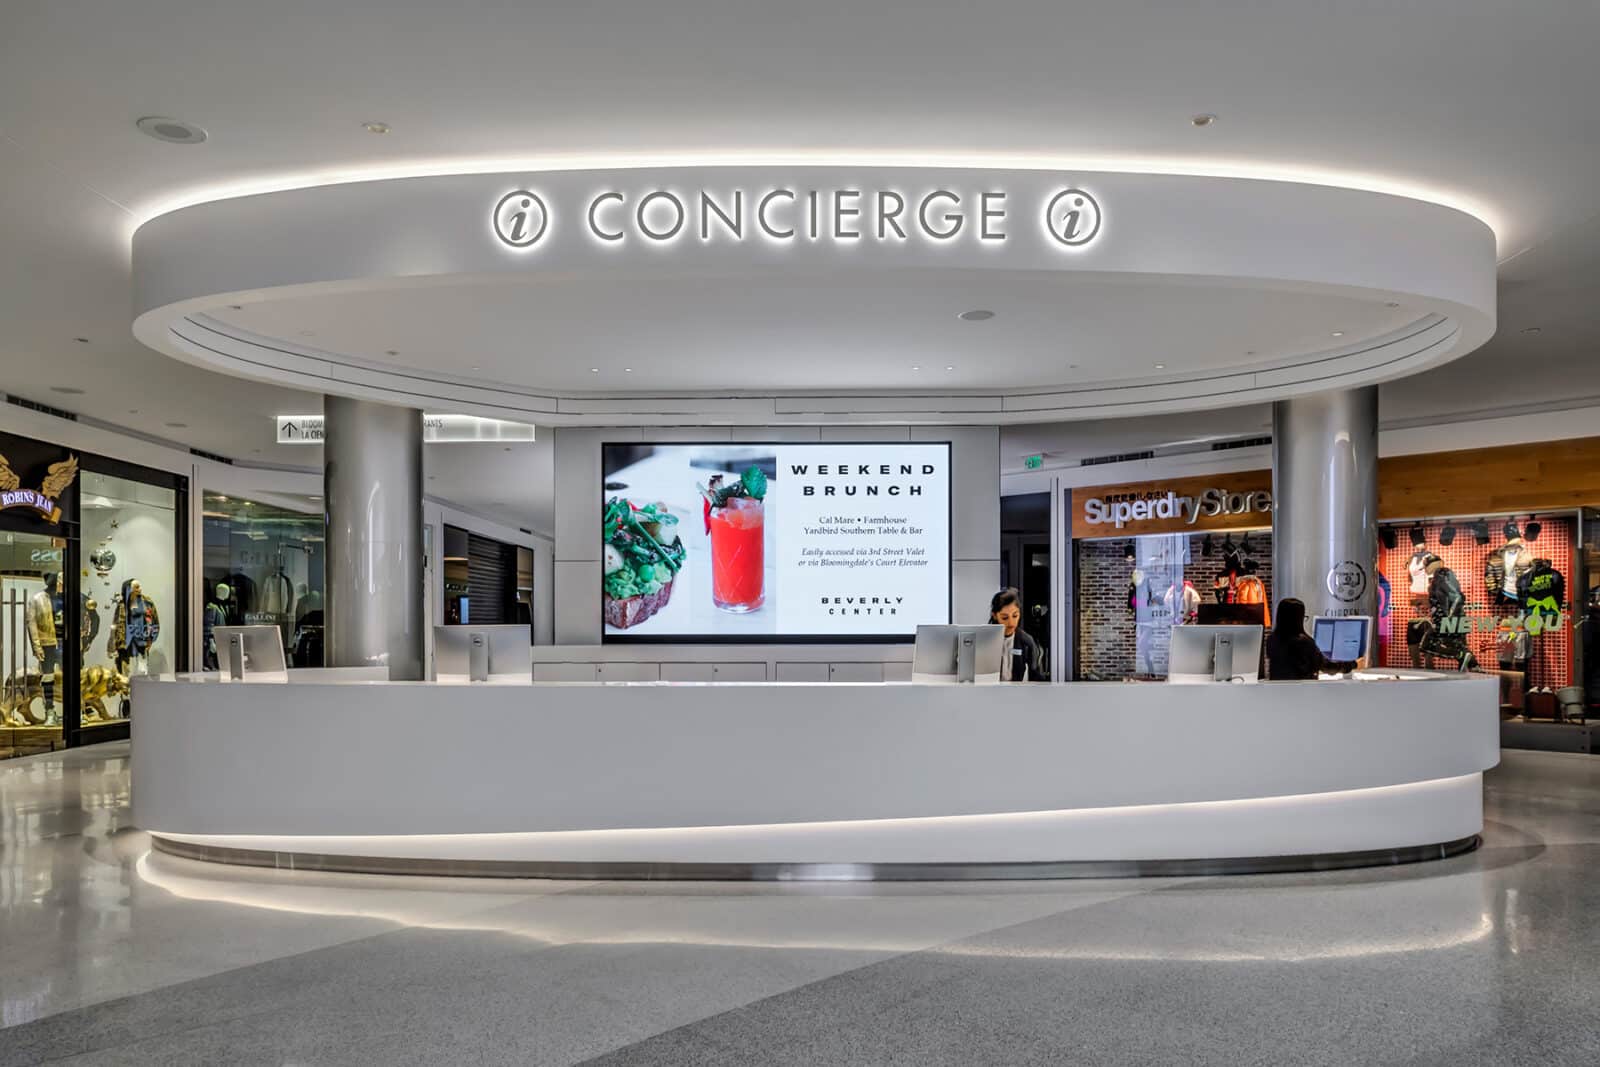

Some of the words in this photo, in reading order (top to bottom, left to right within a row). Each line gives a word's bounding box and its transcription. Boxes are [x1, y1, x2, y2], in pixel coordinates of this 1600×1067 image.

[588, 189, 1006, 241] CONCIERGE
[791, 464, 935, 475] WEEKEND
[803, 485, 922, 496] BRUNCH
[35, 494, 53, 513] JEAN
[818, 515, 832, 524] Cal
[834, 515, 855, 524] Mare
[863, 515, 908, 524] Farmhouse
[803, 526, 839, 535] Yardbird
[840, 526, 875, 535] Southern
[877, 526, 899, 535] Table
[900, 526, 908, 535] &
[909, 526, 923, 535] Bar
[802, 547, 824, 558] Easily
[825, 547, 855, 556] accessed
[856, 548, 868, 556] via
[868, 547, 882, 556] 3rd
[883, 547, 904, 556] Street
[906, 547, 925, 556] Valet
[798, 559, 806, 567] or
[808, 558, 819, 567] via
[820, 558, 874, 569] Bloomingdale's
[875, 558, 897, 567] Court
[898, 558, 928, 567] Elevator
[821, 597, 903, 605] BEVERLY
[1440, 615, 1500, 634] NEW
[1507, 613, 1564, 633] YOU
